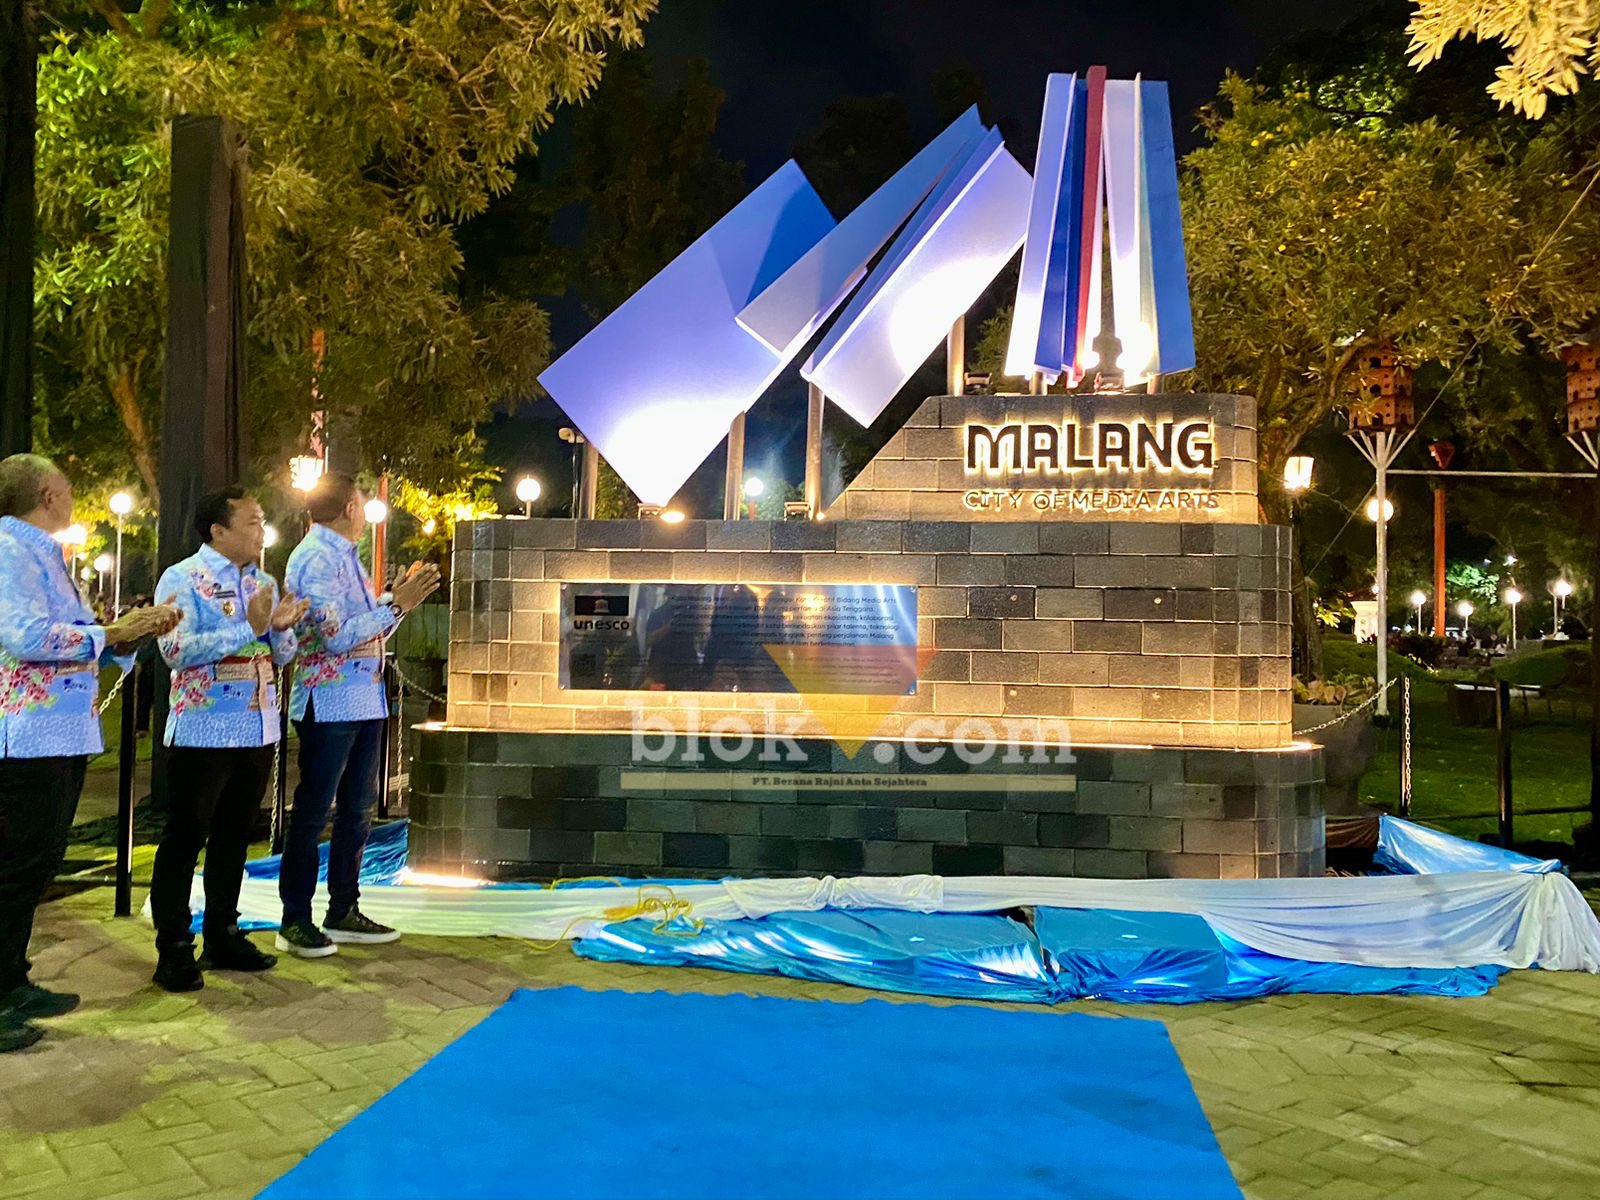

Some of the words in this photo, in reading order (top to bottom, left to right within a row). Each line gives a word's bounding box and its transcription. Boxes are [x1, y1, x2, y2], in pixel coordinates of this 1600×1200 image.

[967, 423, 1213, 469] MALANG
[964, 490, 1023, 510] CITY
[1033, 490, 1066, 510] OF
[1071, 490, 1153, 510] MEDIA
[1155, 490, 1220, 510] ARTS
[574, 619, 630, 631] unesco
